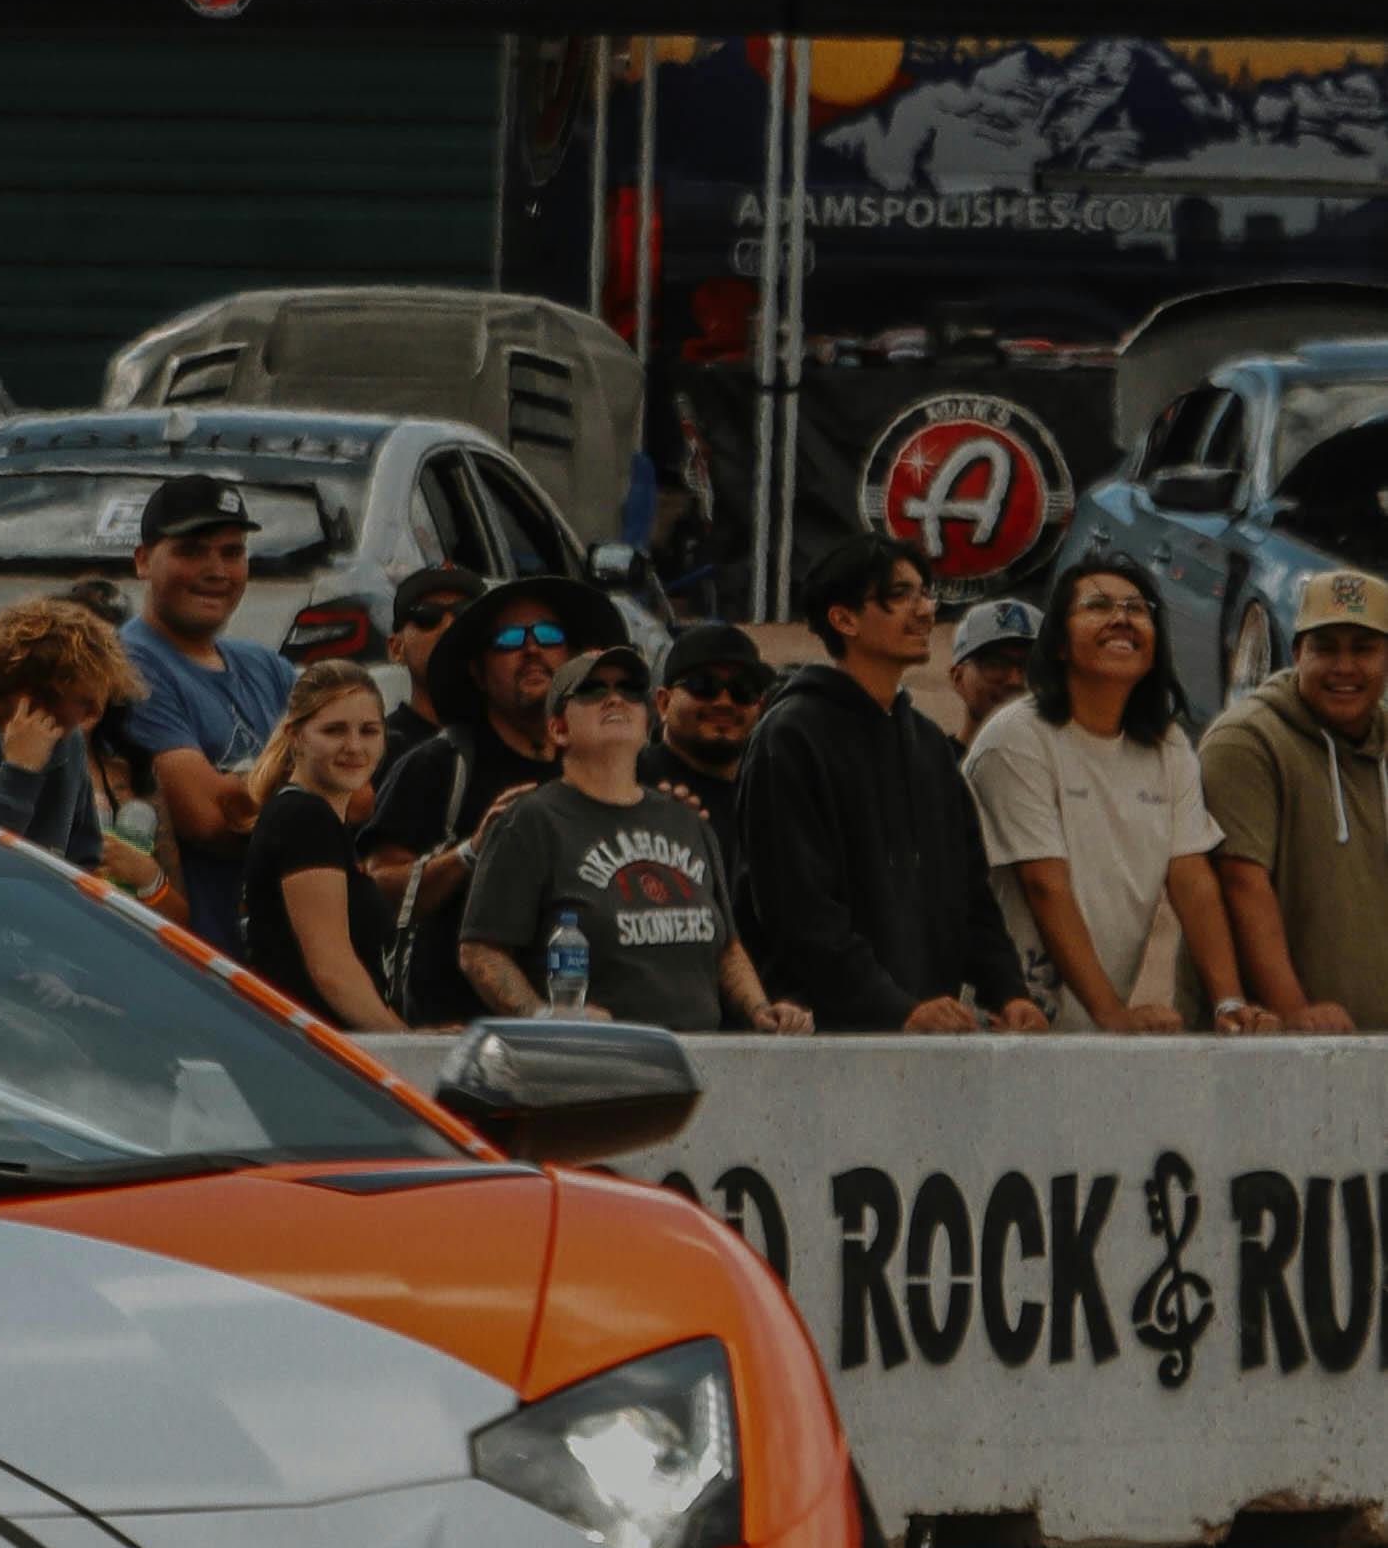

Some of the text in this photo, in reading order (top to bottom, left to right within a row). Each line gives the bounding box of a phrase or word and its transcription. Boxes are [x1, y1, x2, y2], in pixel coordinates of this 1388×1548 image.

[576, 828, 706, 888] OKLAHOMA
[616, 905, 715, 946] SOONERS
[830, 1166, 1122, 1372] ROCK
[1230, 1170, 1388, 1374] RU
